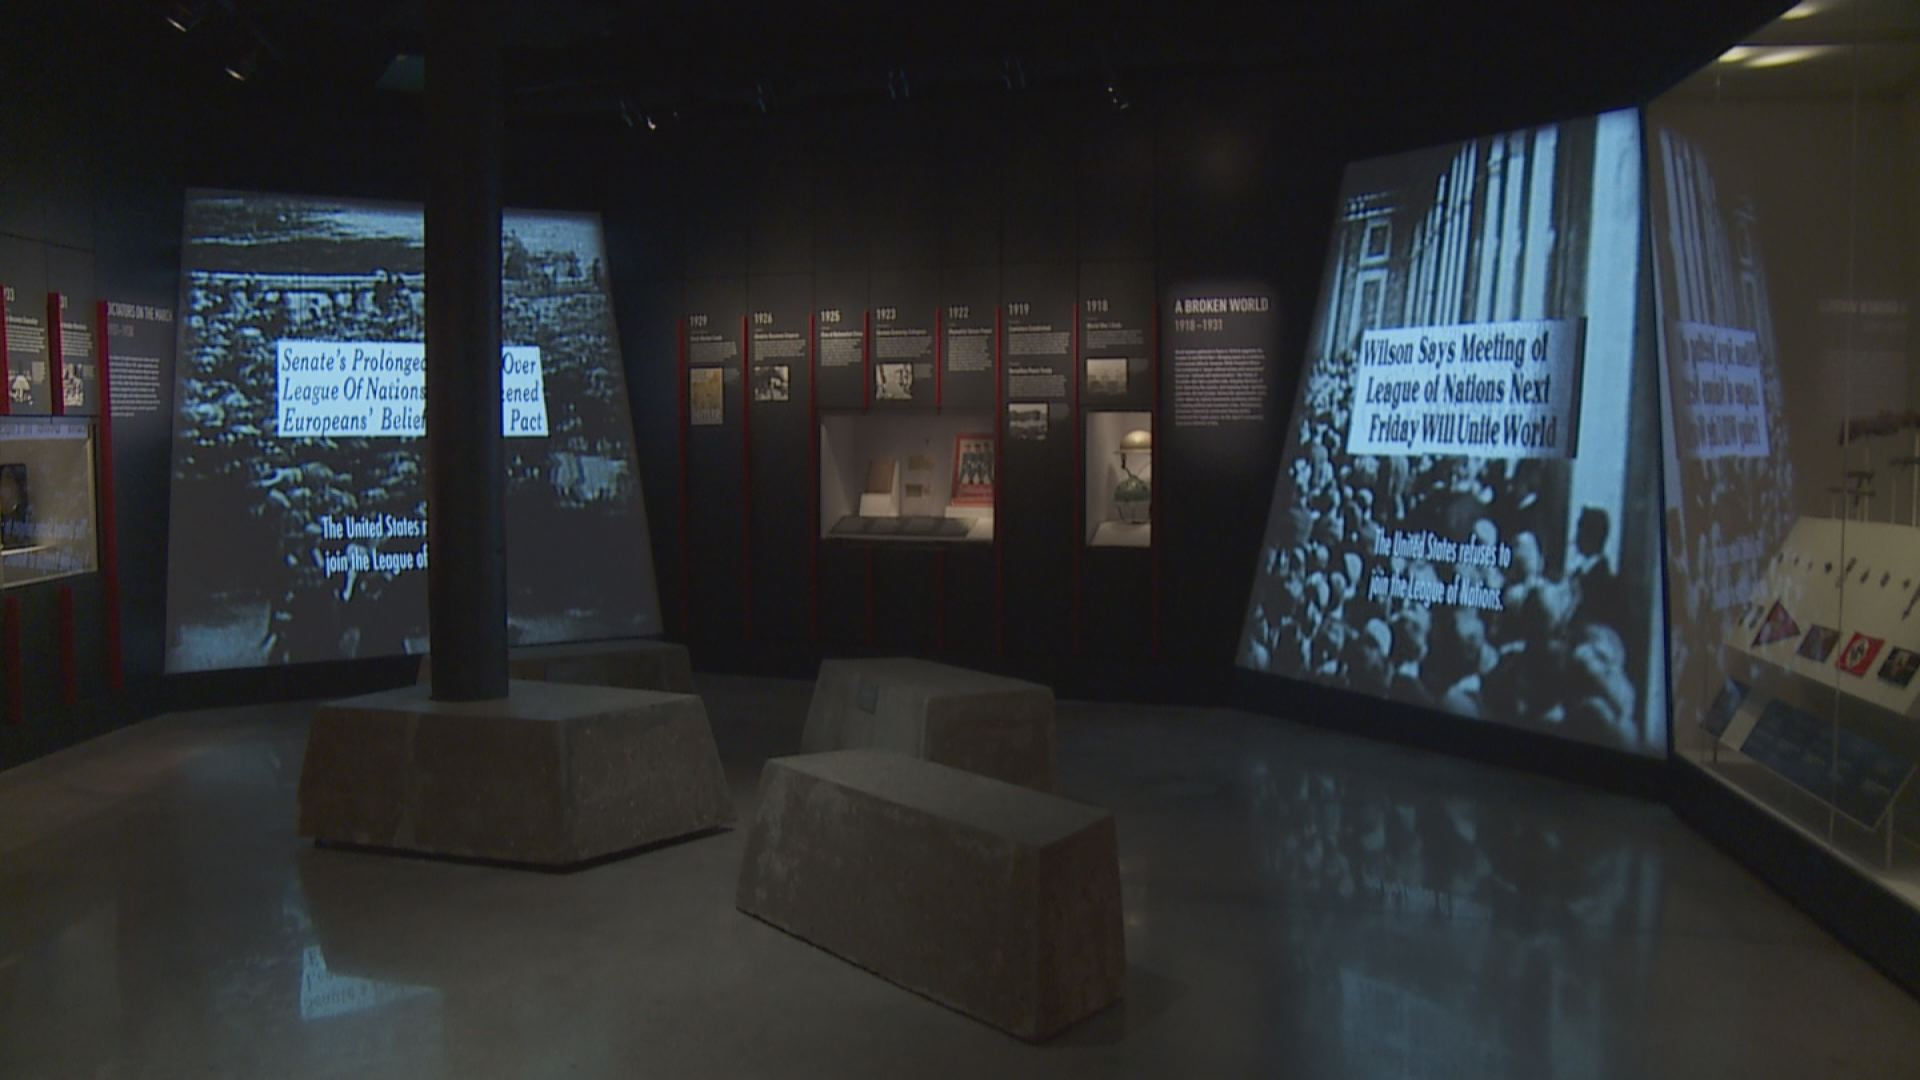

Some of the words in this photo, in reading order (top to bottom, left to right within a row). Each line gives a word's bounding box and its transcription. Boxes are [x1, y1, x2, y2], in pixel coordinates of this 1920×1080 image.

[820, 309, 841, 322] 1925
[876, 308, 897, 321] 1923
[1087, 299, 1108, 312] 1918
[1175, 299, 1184, 313] A
[1185, 298, 1227, 314] BROKEN
[1229, 297, 1269, 312] WORLD
[281, 348, 346, 372] Senate's
[503, 352, 536, 374] Over
[1364, 338, 1413, 366] Wilson
[1418, 336, 1456, 369] Says
[1460, 333, 1526, 368] Meeting
[1531, 331, 1549, 362] of
[283, 377, 339, 405] League
[344, 376, 364, 401] Of
[366, 377, 427, 401] Nations
[503, 381, 539, 402] ened
[1366, 376, 1420, 410] League
[1424, 374, 1440, 403] of
[1444, 373, 1505, 404] Nations
[1510, 373, 1551, 404] Next
[284, 407, 373, 437] Europeans'
[511, 408, 542, 431] Pact
[1368, 413, 1420, 449] Friday
[1422, 413, 1455, 443] Will
[1458, 414, 1500, 445] Unite
[1504, 413, 1557, 448] World
[322, 515, 344, 540] The
[346, 513, 384, 539] United
[385, 514, 420, 537] States
[1374, 526, 1392, 557] The
[1393, 528, 1426, 560] United
[1426, 531, 1457, 562] States
[1458, 533, 1497, 567] refuses
[1499, 542, 1511, 569] to
[324, 550, 348, 579] join
[350, 546, 370, 572] the
[372, 546, 414, 576] League
[1368, 565, 1389, 602] join
[1390, 570, 1408, 599] the
[1409, 570, 1445, 609] League
[1447, 574, 1460, 606] of
